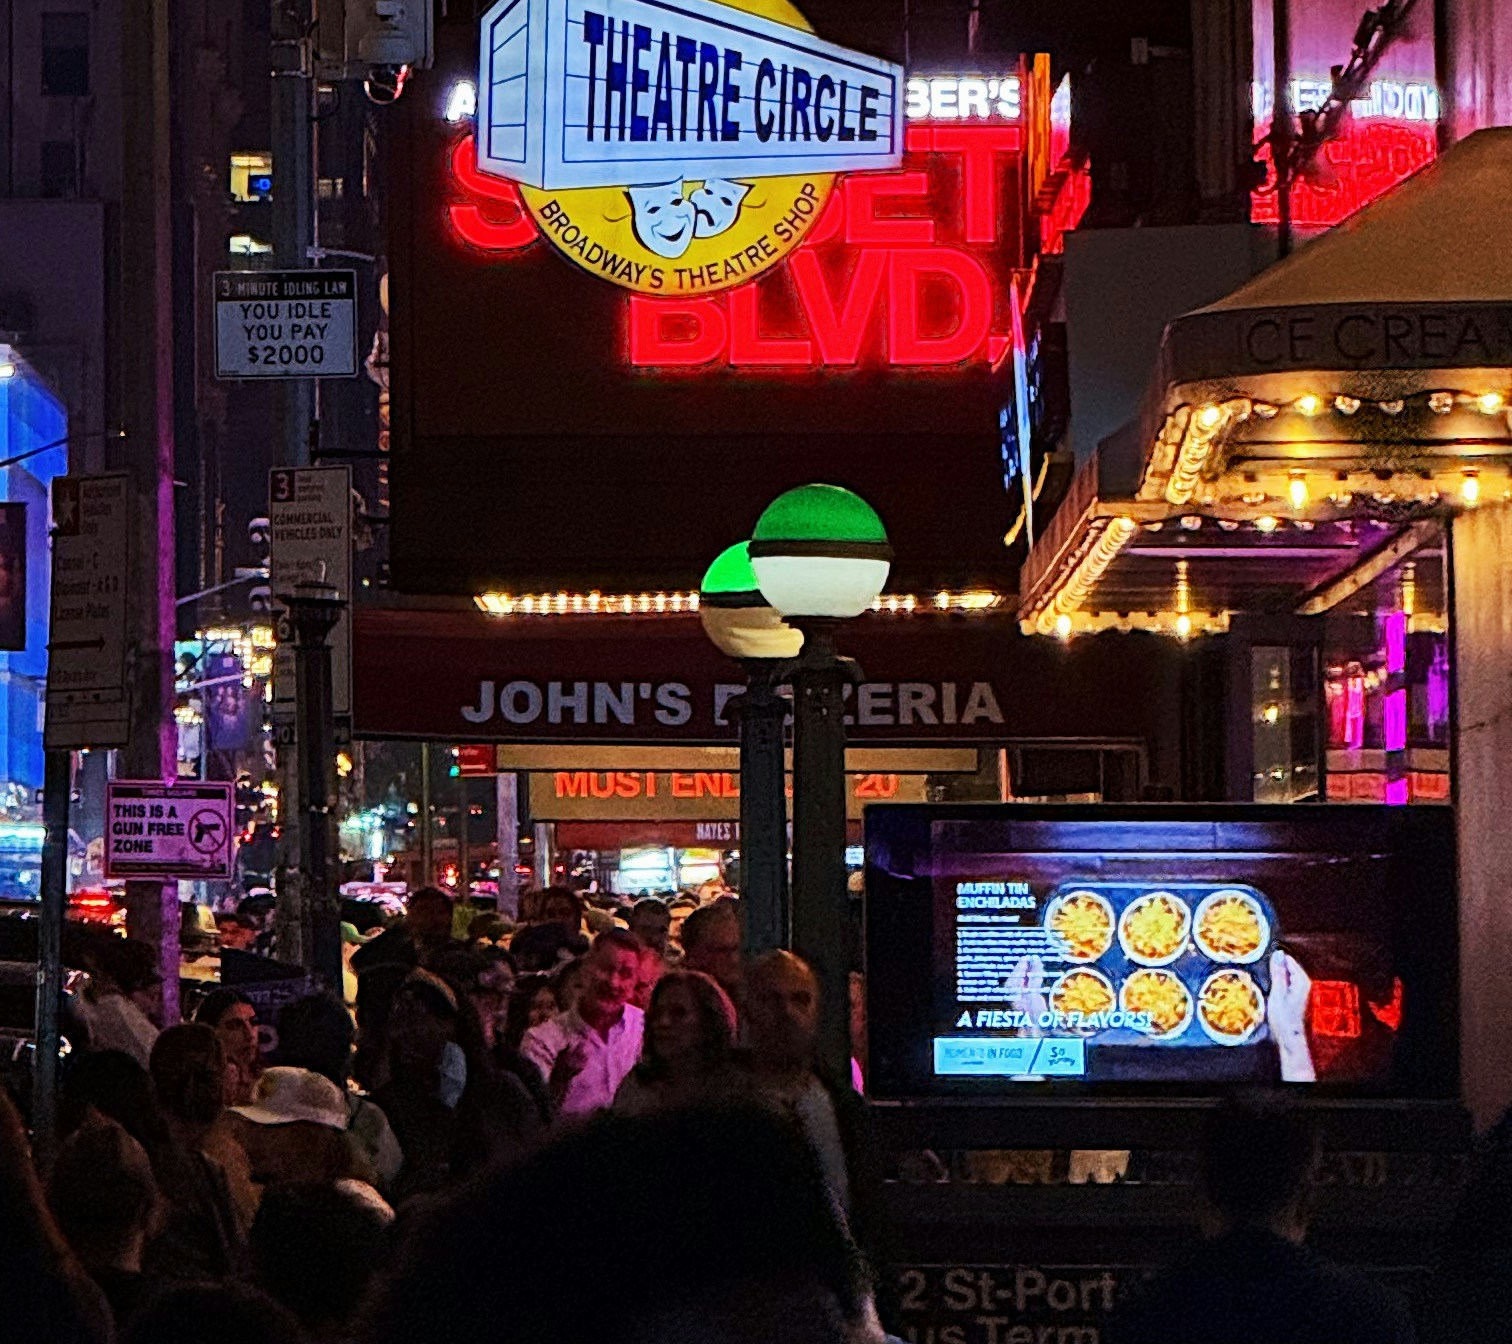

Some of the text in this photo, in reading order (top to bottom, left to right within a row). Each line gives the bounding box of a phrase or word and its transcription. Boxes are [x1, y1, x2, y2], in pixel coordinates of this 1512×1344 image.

[583, 10, 881, 143] THEATRE CIRCLE
[906, 77, 1020, 119] BER'S
[449, 124, 1022, 249] SET
[538, 182, 821, 289] BROADWAY'S THEATRE SHOP
[221, 280, 348, 297] 3 MINUTE IDLING LAW
[240, 302, 331, 320] YOU IDLE
[244, 323, 328, 341] YOU PAY
[1334, 313, 1512, 362] CREA
[248, 344, 324, 365] $2000
[274, 472, 290, 500] 3
[461, 679, 1005, 727] JOHN'S PERIA
[555, 771, 657, 798] MUST
[113, 804, 178, 818] THIS IS A
[113, 822, 185, 836] GUN FREE
[695, 822, 731, 841] HAYES
[113, 839, 154, 853] ZONE
[956, 882, 1029, 895] MUFFIN TIN
[955, 896, 1037, 909] ENCHILADAS
[956, 1009, 973, 1028] A
[975, 1009, 1033, 1028] FIESTA
[1038, 1011, 1065, 1028] OF
[899, 1268, 930, 1310] 2
